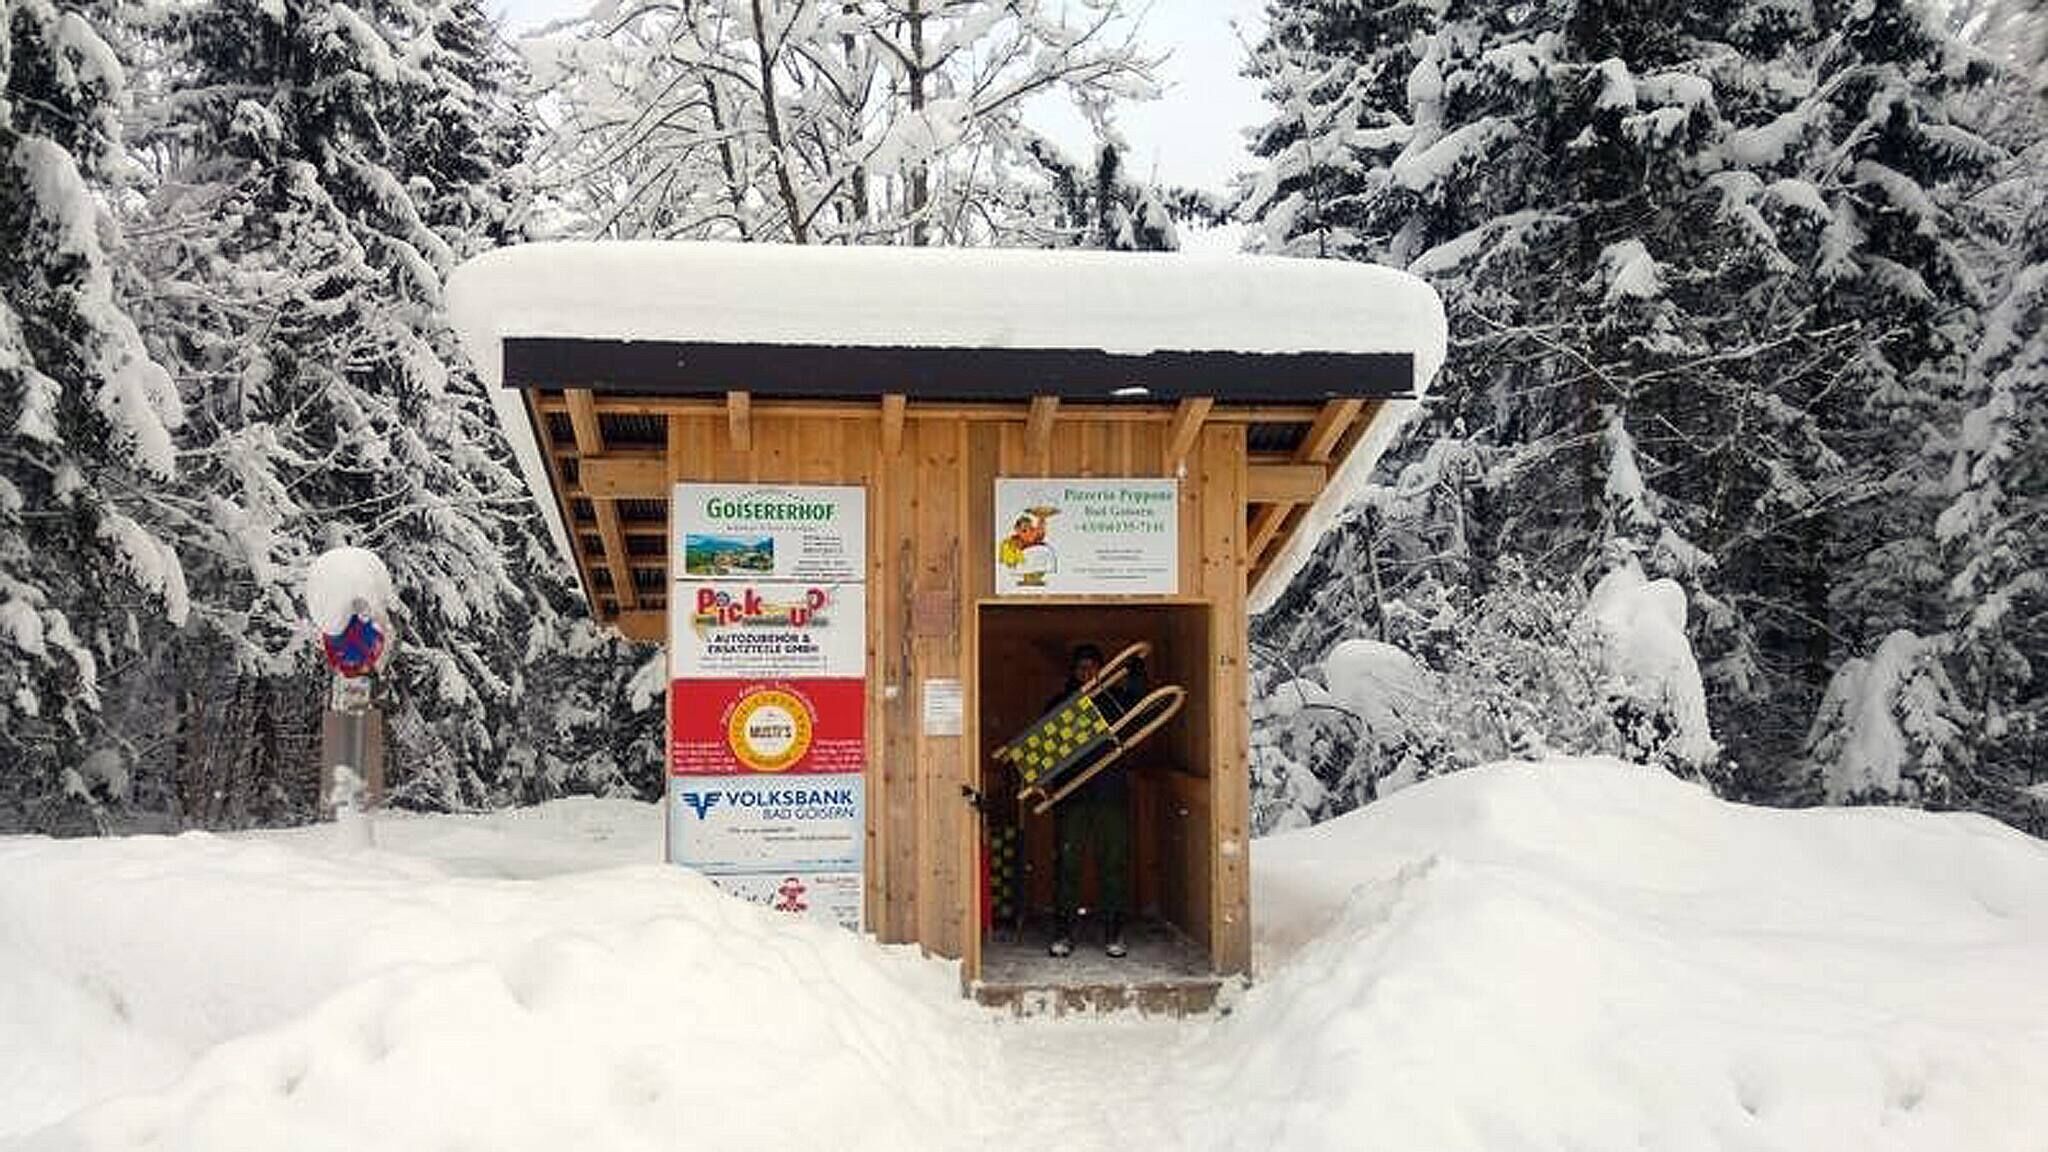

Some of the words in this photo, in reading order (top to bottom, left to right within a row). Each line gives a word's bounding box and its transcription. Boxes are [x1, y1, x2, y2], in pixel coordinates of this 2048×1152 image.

[696, 587, 762, 626] Pick
[726, 790, 854, 807] VOLKSBANK
[762, 808, 792, 820] BAD
[796, 808, 855, 820] GOISERN
